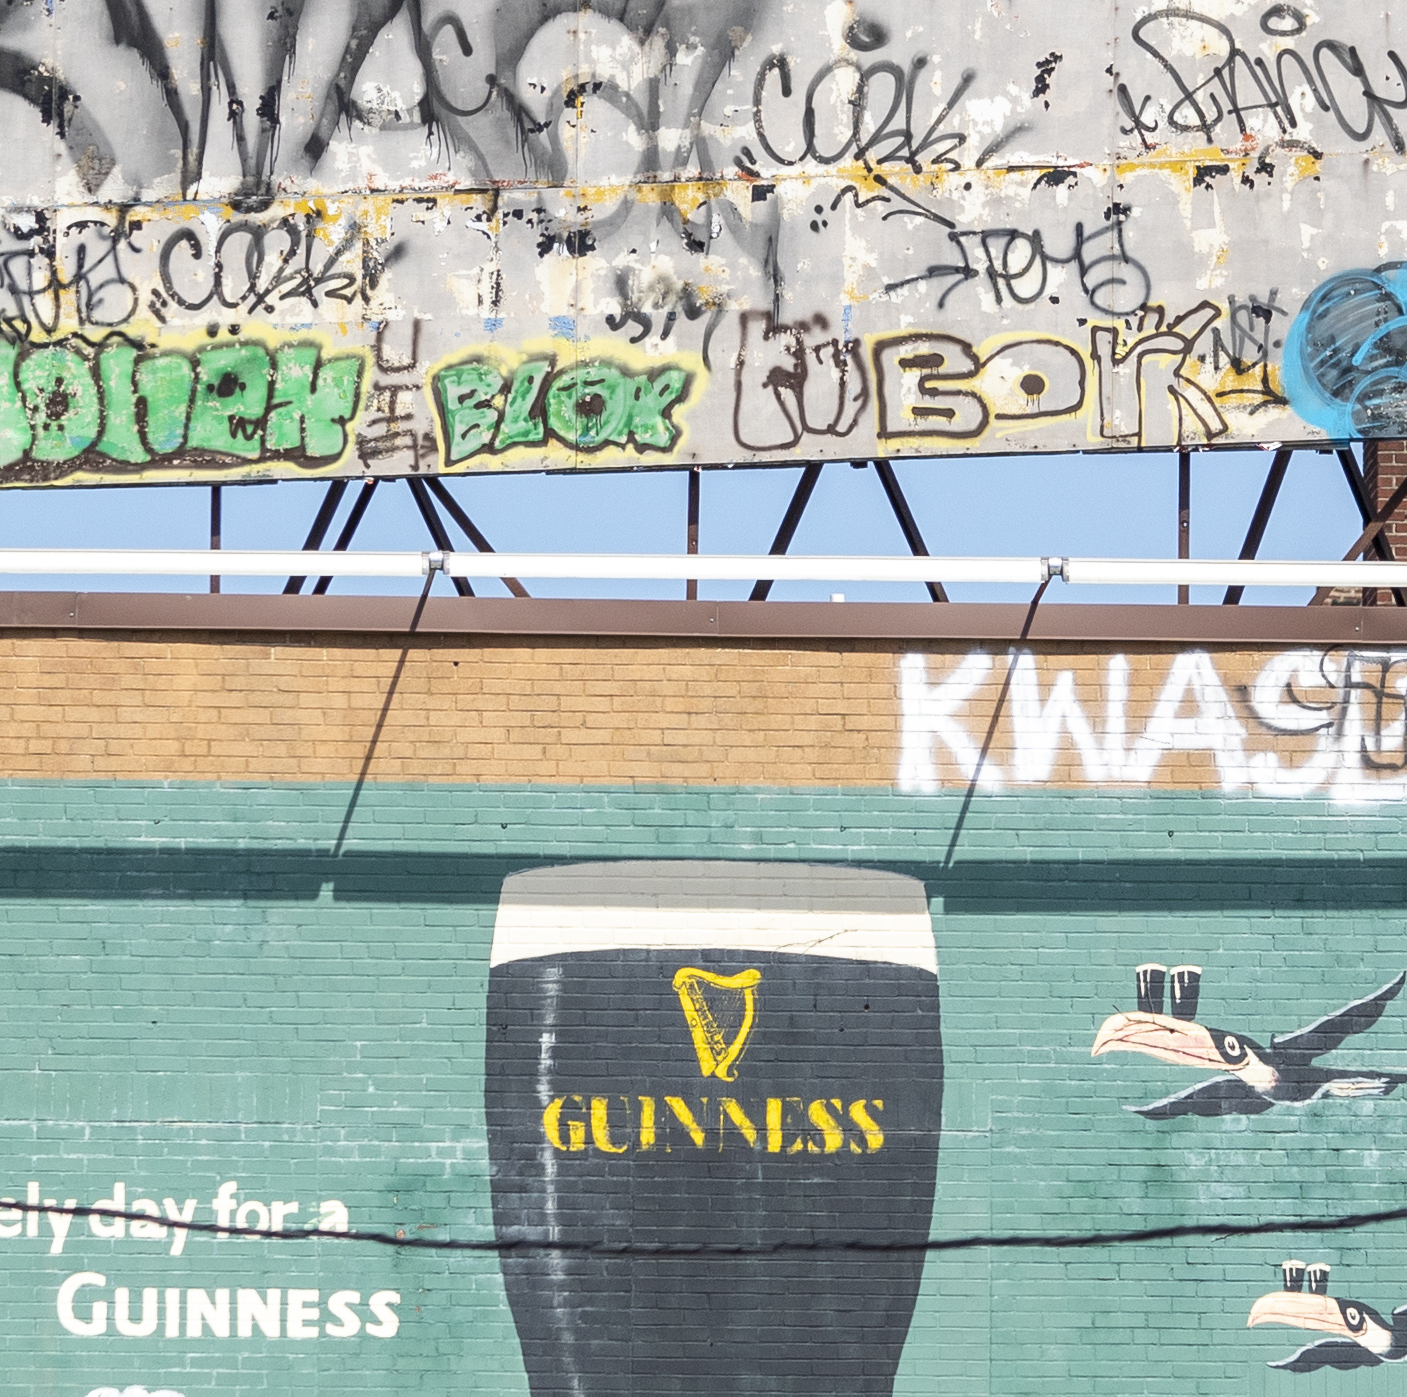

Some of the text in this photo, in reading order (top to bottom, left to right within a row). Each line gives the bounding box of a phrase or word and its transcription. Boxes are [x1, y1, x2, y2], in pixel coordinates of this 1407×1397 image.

[542, 1095, 885, 1154] GUINNESS
[90, 1181, 197, 1255] day
[212, 1181, 299, 1238] for
[310, 1198, 350, 1239] a
[56, 1270, 401, 1337] GUINNESS
